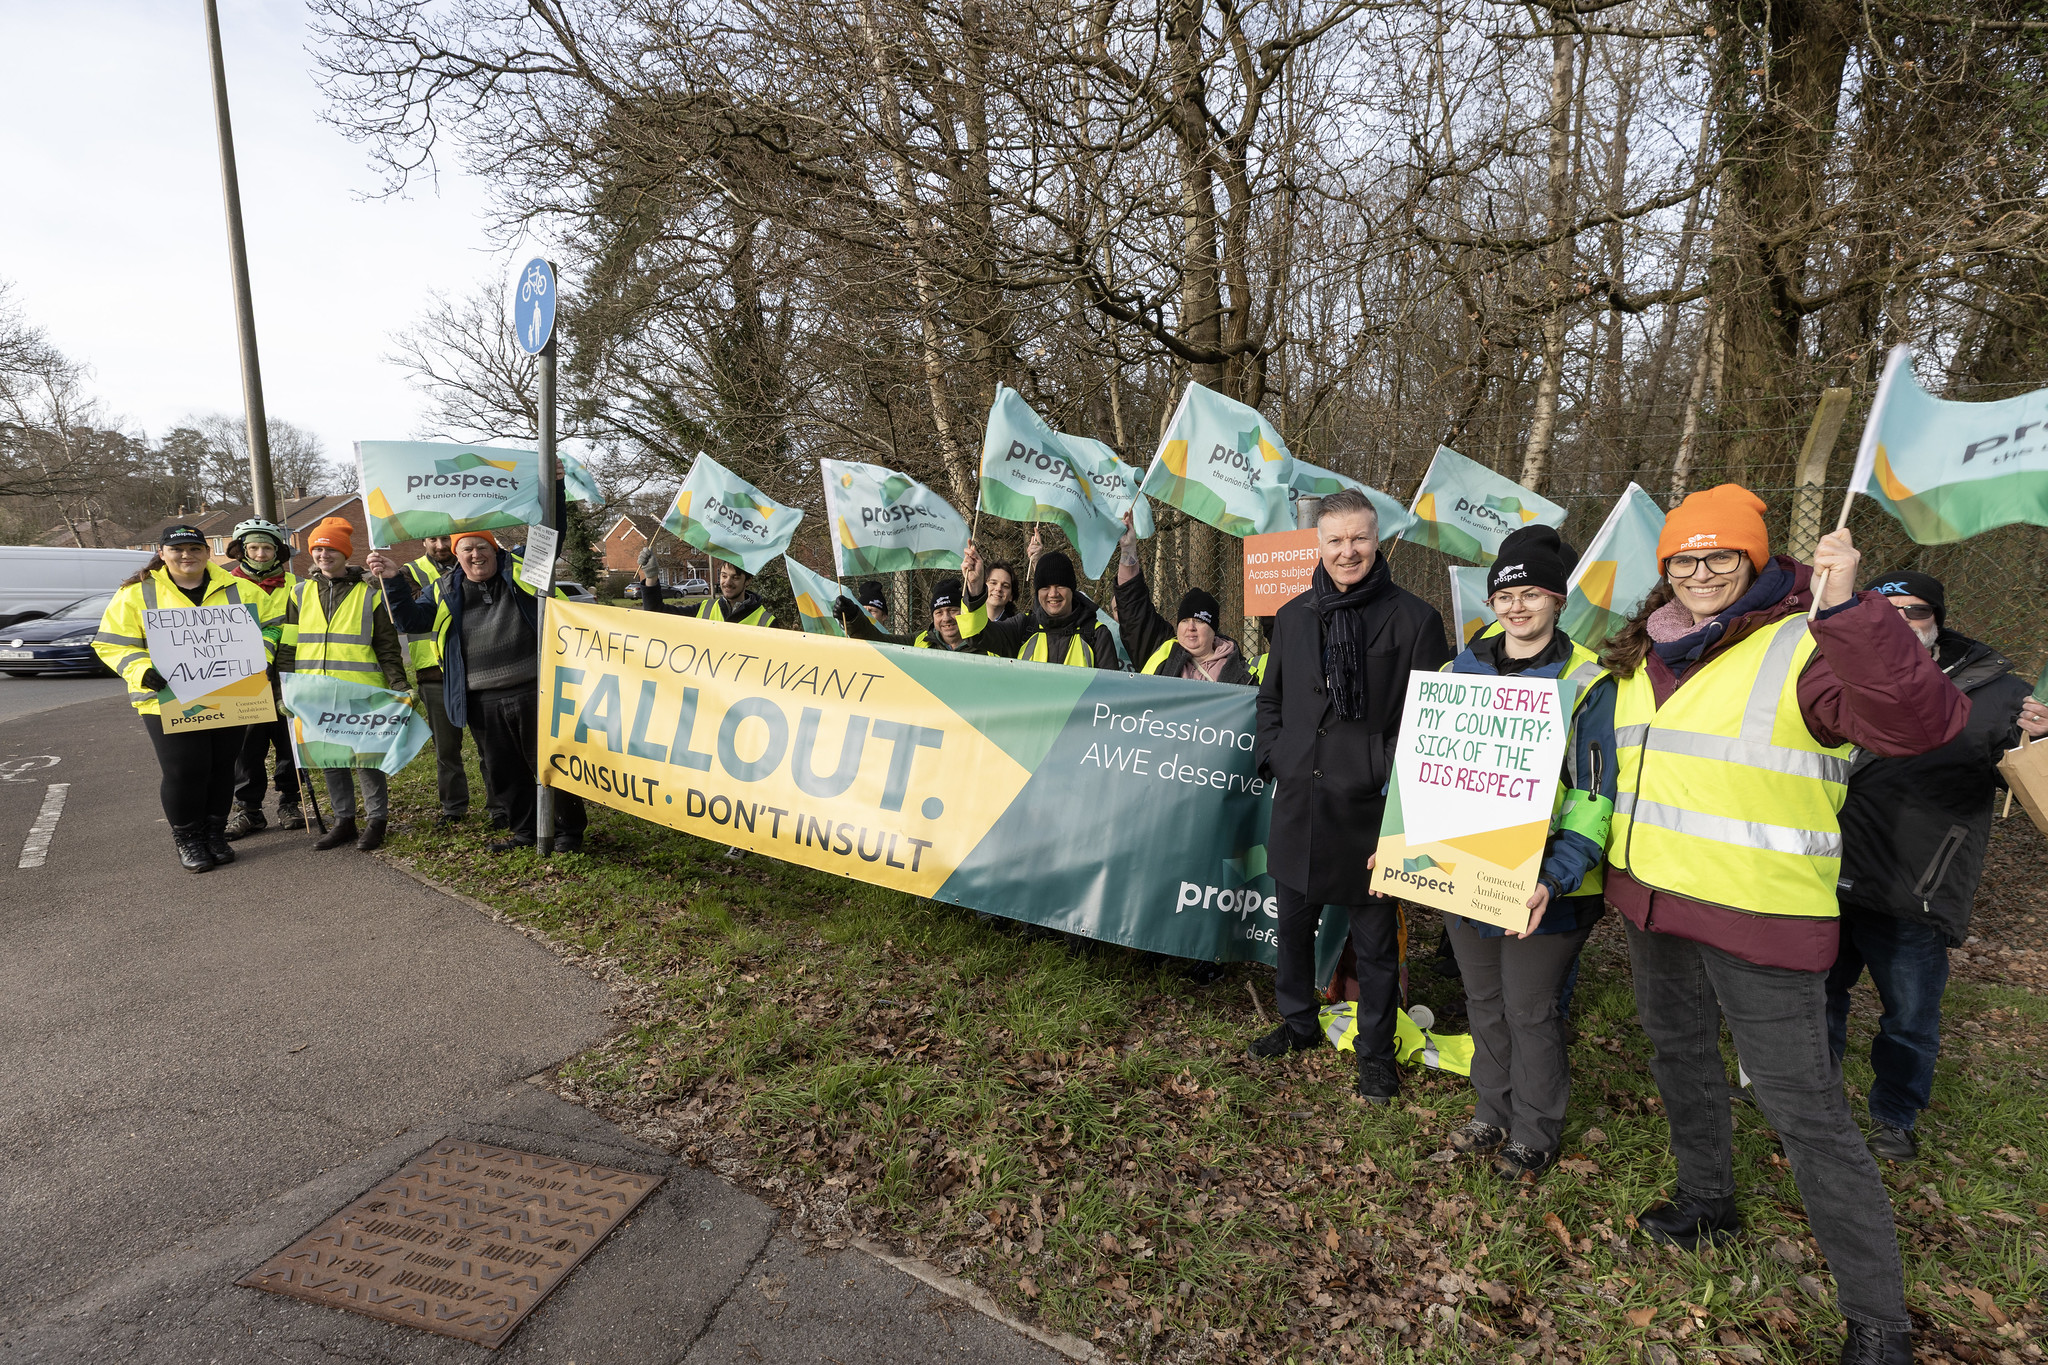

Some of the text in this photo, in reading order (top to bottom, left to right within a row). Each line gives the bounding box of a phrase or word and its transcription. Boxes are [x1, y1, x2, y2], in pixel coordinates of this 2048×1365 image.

[1962, 420, 2048, 464] pr
[407, 474, 519, 494] prospect
[1012, 469, 1026, 481] the
[1028, 477, 1051, 486] union
[1052, 481, 1066, 491] for
[1212, 470, 1224, 481] the
[1225, 475, 1242, 487] union
[417, 493, 431, 501] the
[472, 492, 508, 501] ambition
[704, 496, 769, 538] prospect
[1460, 516, 1472, 524] the
[1472, 522, 1492, 532] union
[873, 529, 886, 537] the
[1681, 540, 1718, 550] prospect
[1247, 548, 1319, 565] MOD PROPERT
[1248, 565, 1314, 580] Access subject
[1493, 570, 1528, 586] prospect
[1255, 583, 1278, 595] MOD
[147, 606, 252, 630] REDUNDANCY:
[170, 628, 244, 646] LAWFUL.
[193, 644, 227, 659] NOT
[168, 659, 261, 682] AWEFUL
[556, 625, 885, 703] STAFF DON'T WANT
[1418, 681, 1553, 714] PROUD TO SERVE
[170, 712, 225, 727] prospect
[1092, 702, 1256, 752] Professiona
[1417, 707, 1552, 743] MY COUNTRY:
[550, 665, 945, 821] FALLOUT.
[1415, 734, 1534, 772] SICK OF THE
[1080, 742, 1152, 776] AWE
[1158, 753, 1264, 796] deserve
[549, 752, 933, 873] CONSULT DON'T INSULT
[1383, 866, 1455, 895] prospect
[1476, 870, 1526, 892] Connected.
[1175, 880, 1279, 922] prospe
[1473, 885, 1522, 906] Ambitious.
[1470, 898, 1502, 917] Strong.
[471, 1242, 544, 1268] RAPIDE
[386, 1269, 478, 1301] STANTON
